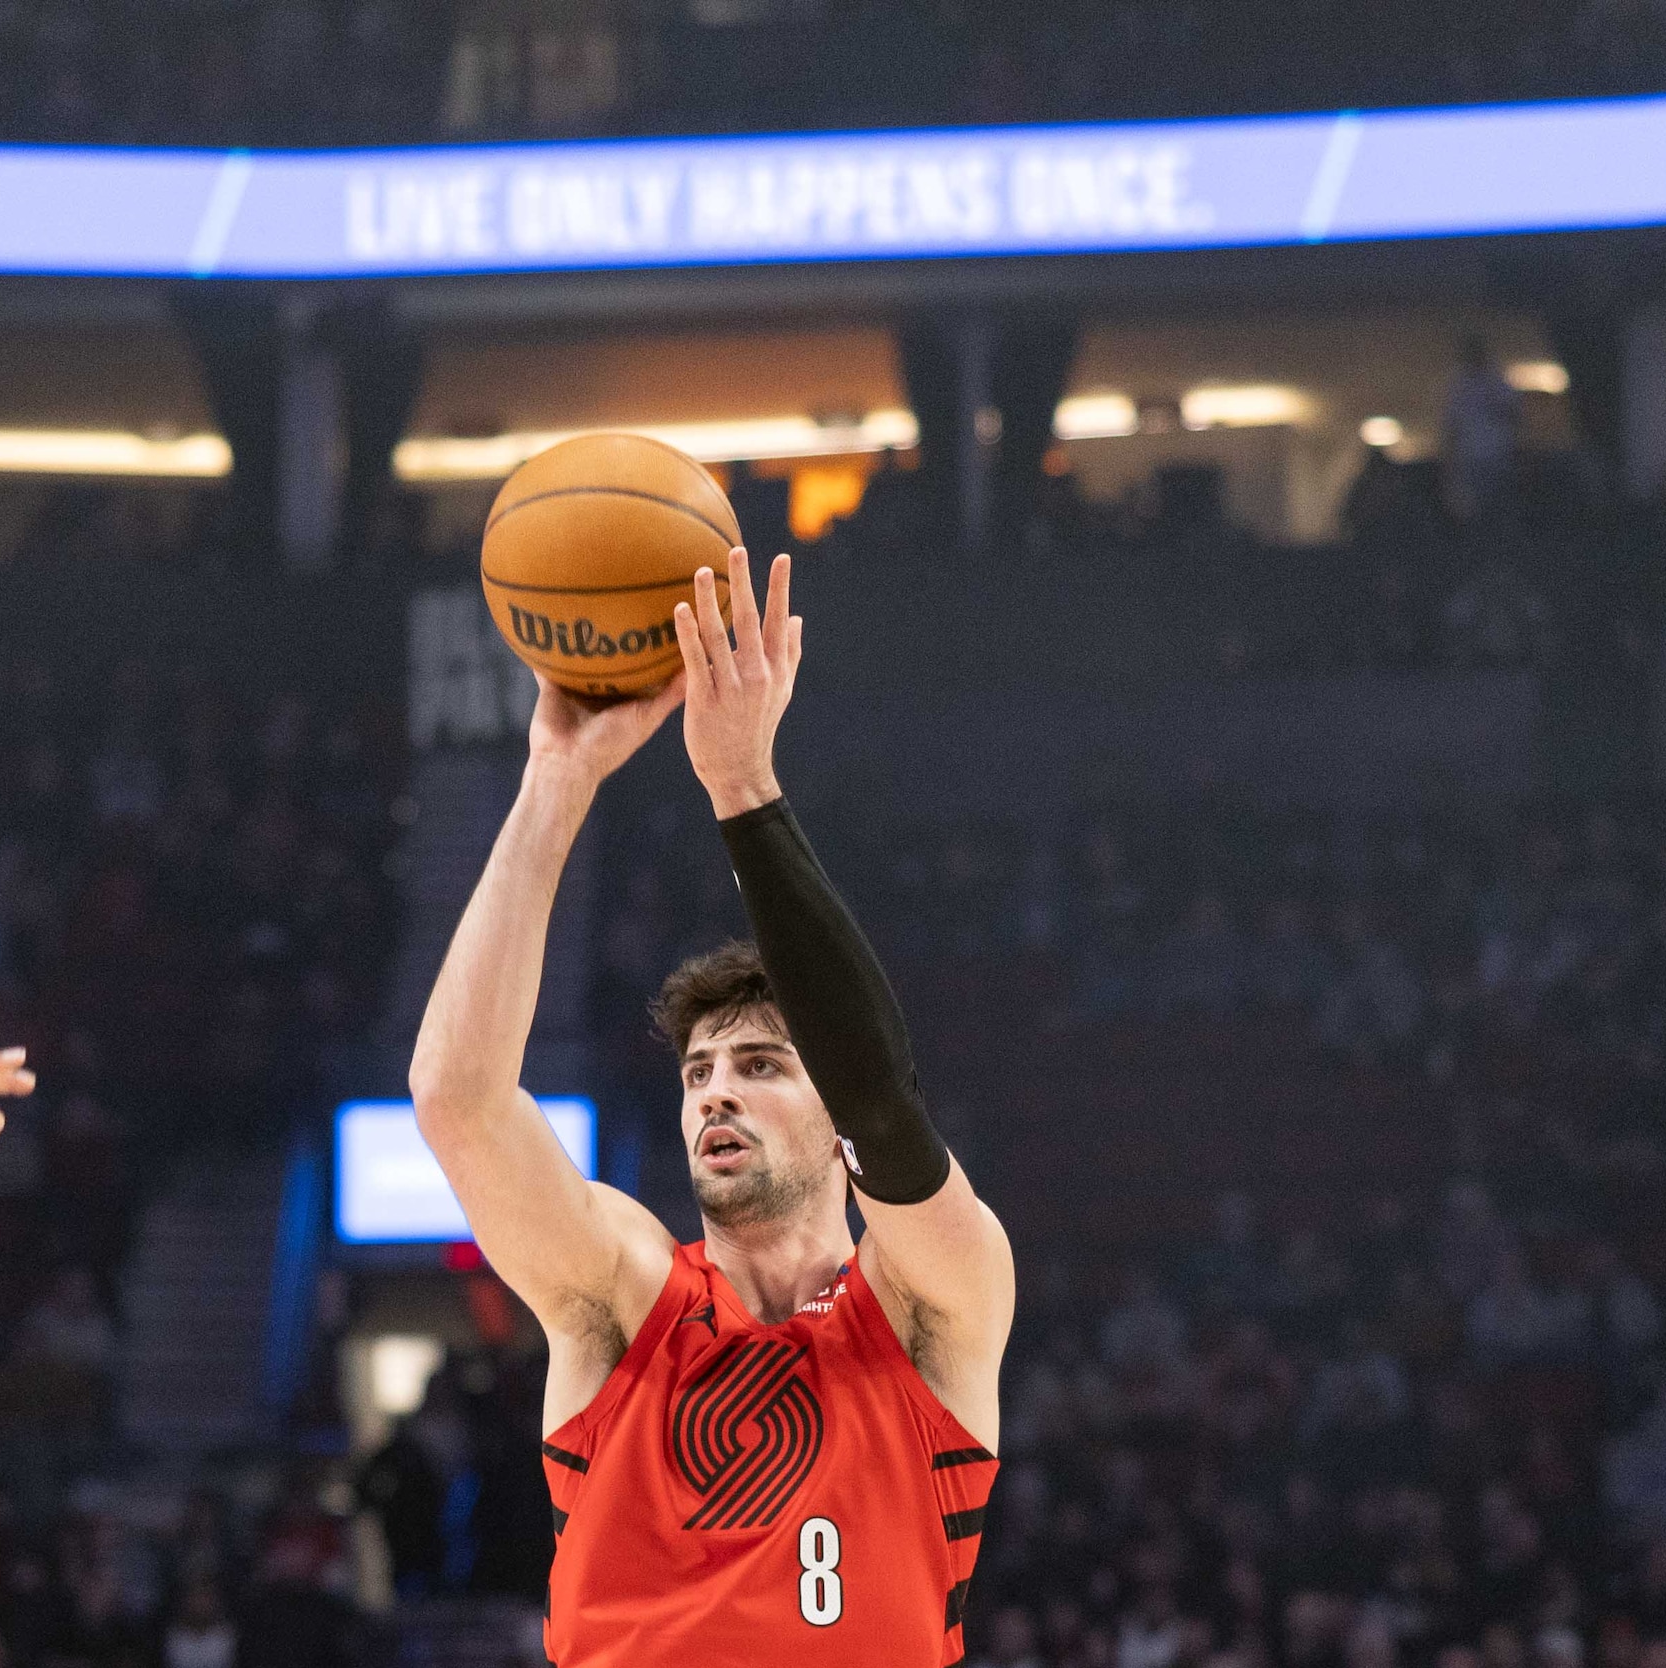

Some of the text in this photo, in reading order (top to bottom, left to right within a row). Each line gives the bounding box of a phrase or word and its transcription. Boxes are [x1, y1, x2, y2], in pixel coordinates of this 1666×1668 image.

[345, 166, 497, 259] LIVE
[508, 163, 683, 251] ONLY
[690, 149, 997, 245] HAPPENS
[509, 602, 679, 657] Wilson
[799, 1516, 842, 1627] 8
